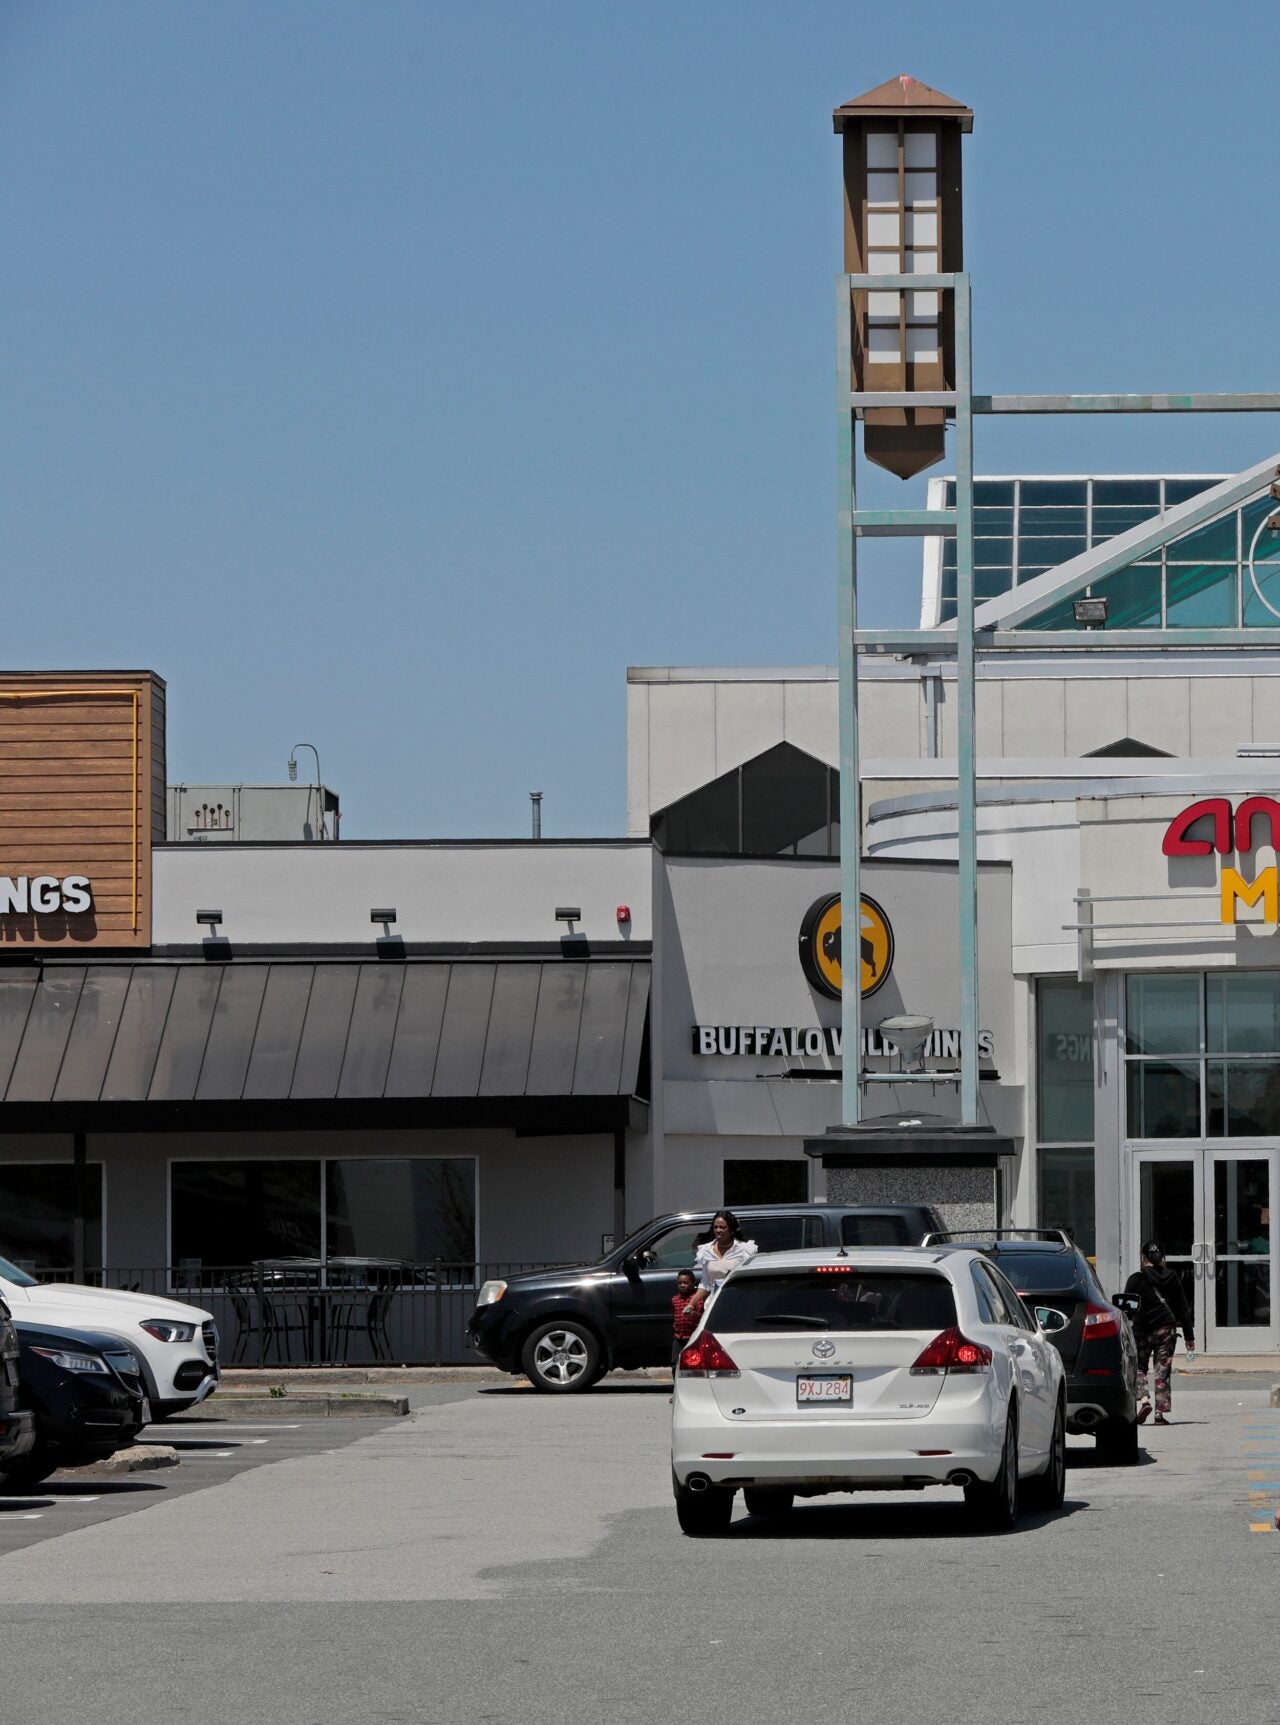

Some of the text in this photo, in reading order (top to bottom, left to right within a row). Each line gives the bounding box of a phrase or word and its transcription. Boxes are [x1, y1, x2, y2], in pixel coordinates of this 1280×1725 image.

[699, 1026, 824, 1056] BUFFALO
[922, 1029, 994, 1059] INS
[800, 1381, 848, 1396] 9XJ 284
